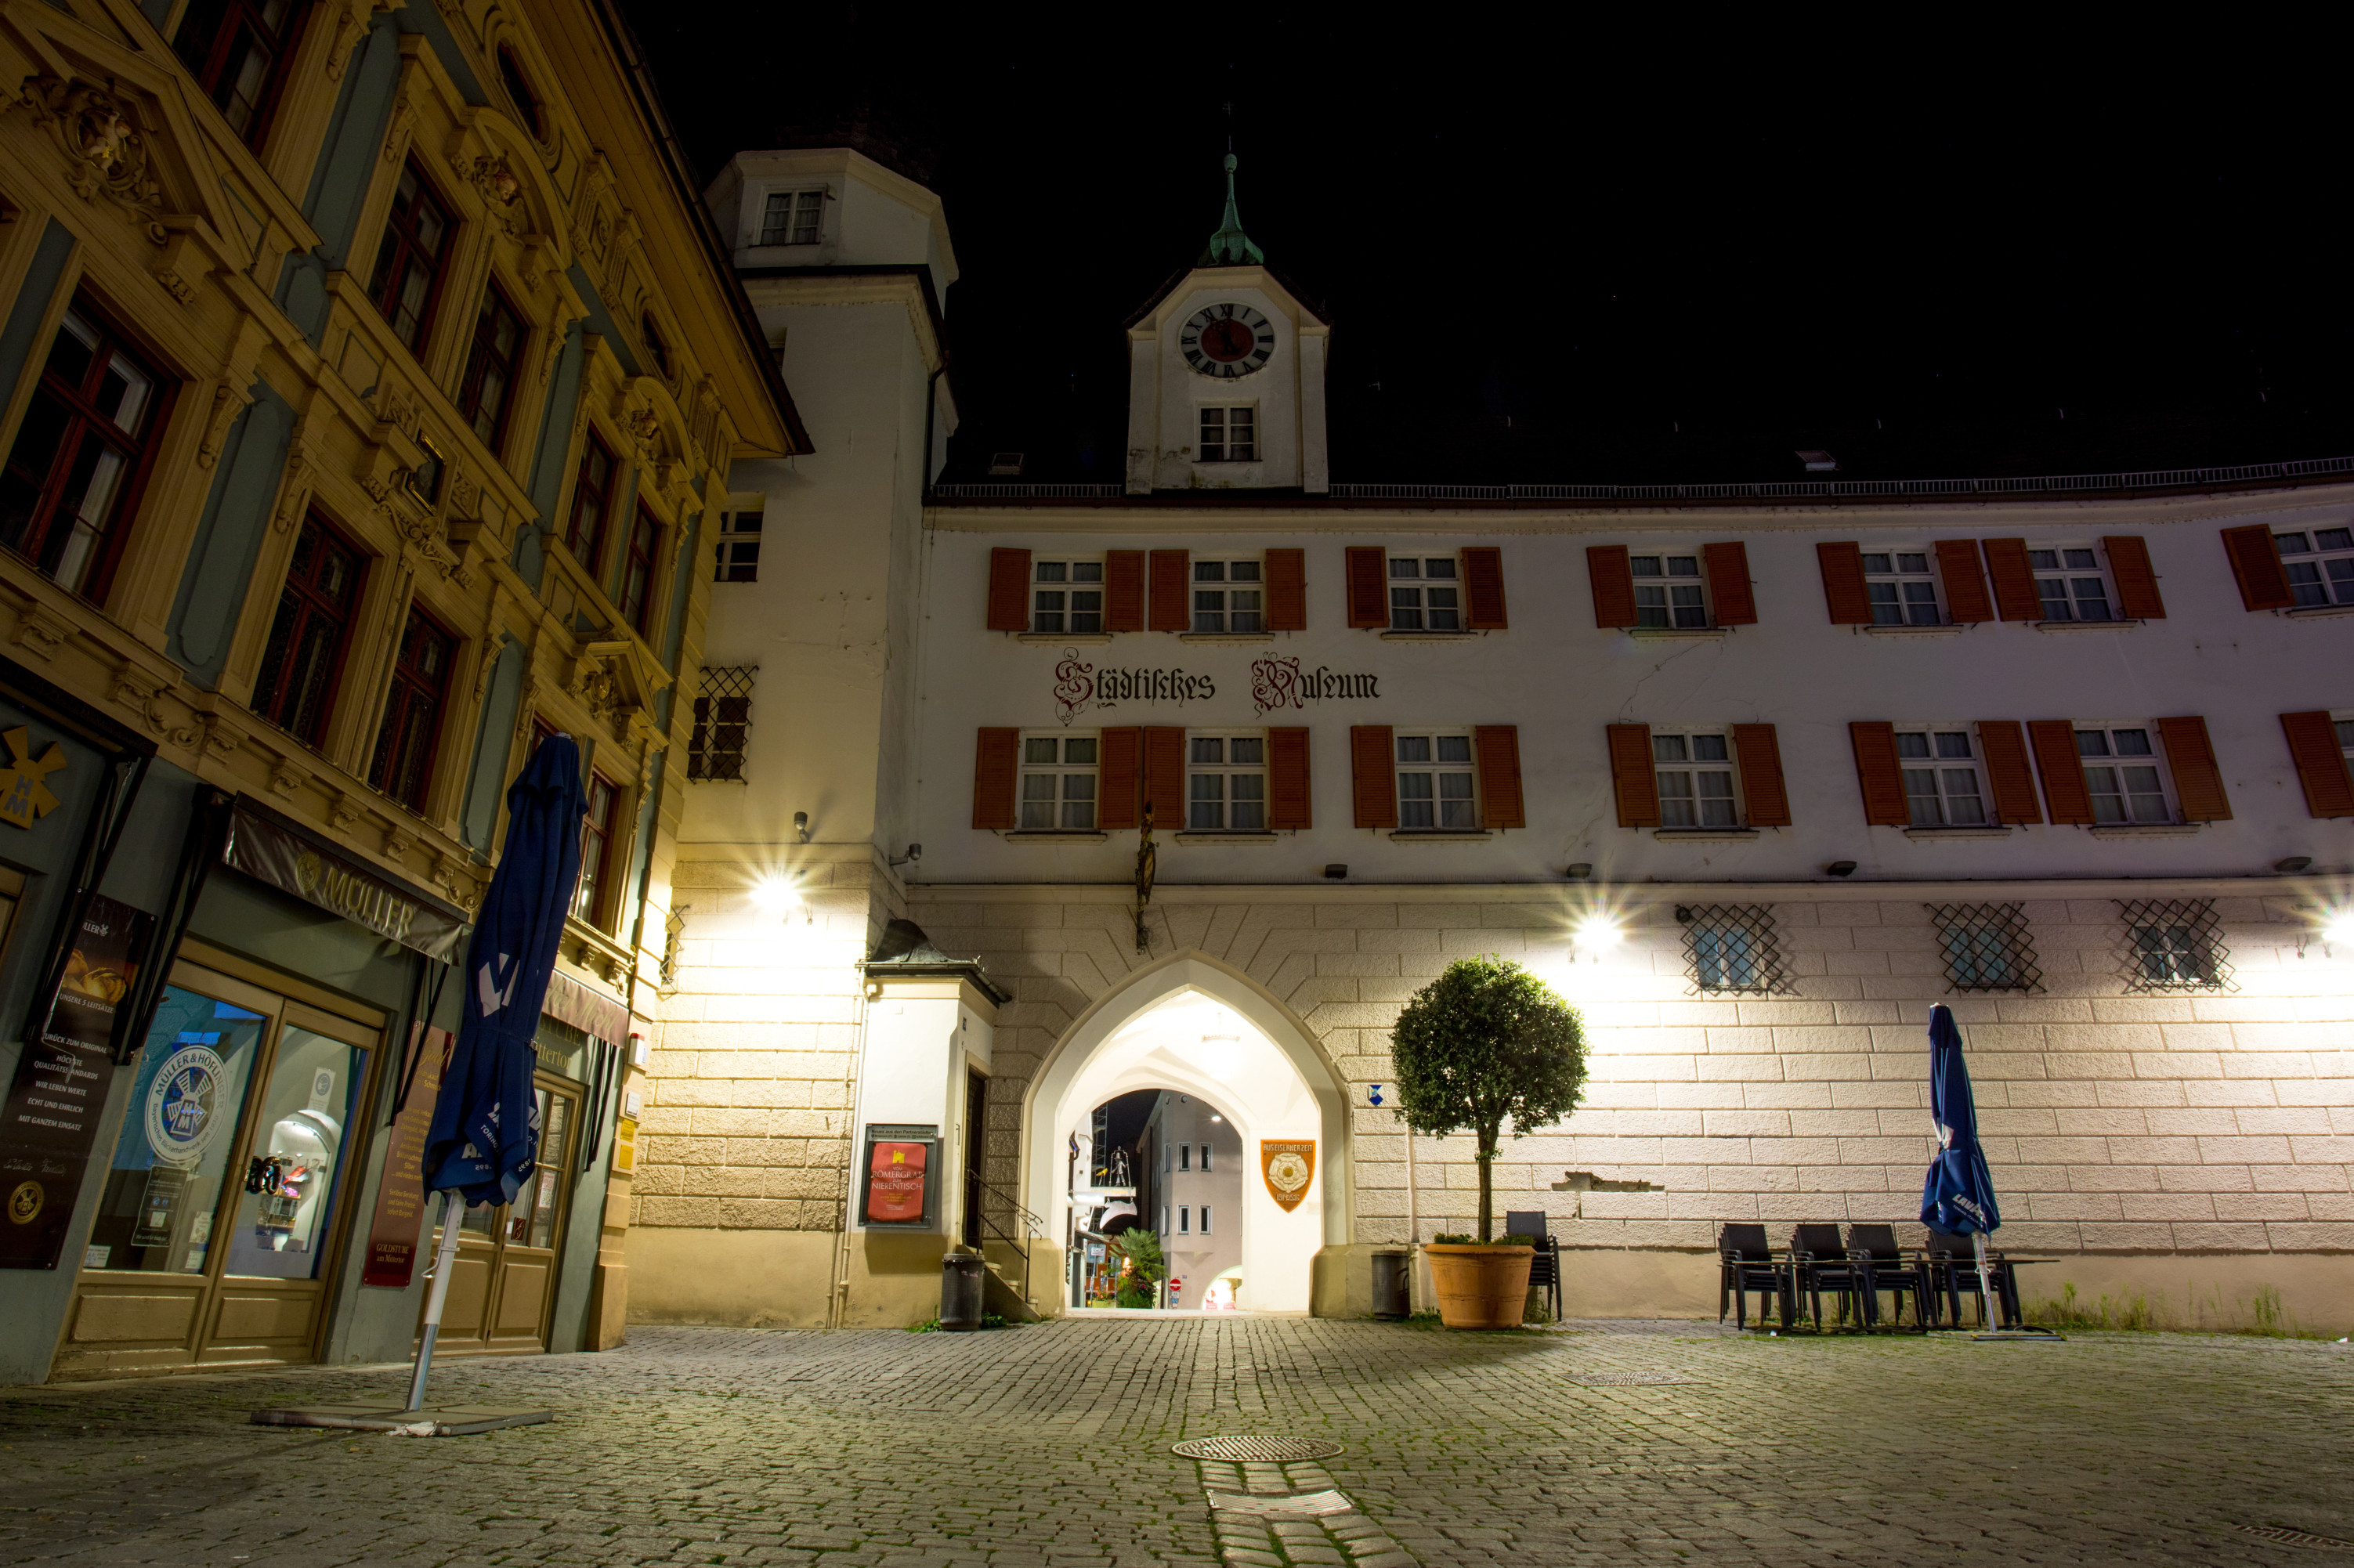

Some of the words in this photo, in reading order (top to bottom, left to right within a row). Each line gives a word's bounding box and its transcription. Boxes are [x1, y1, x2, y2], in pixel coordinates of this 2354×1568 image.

[1220, 304, 1234, 316] XI
[1251, 652, 1381, 720] Museum
[323, 866, 414, 939] MÜLLER
[83, 922, 99, 934] LLER
[60, 993, 81, 1006] UNSERE
[87, 1000, 114, 1013] LEITSÄTZE
[540, 1019, 580, 1046] STUBE
[45, 1032, 65, 1044] URÜCK
[66, 1039, 80, 1047] ZUM
[81, 1042, 107, 1053] ORIGINAL
[537, 1036, 573, 1070] ittertor
[34, 1060, 99, 1080] QUALITÄTSSANDARDS
[35, 1080, 49, 1089] WIR
[49, 1082, 67, 1093] LEBEN
[67, 1086, 86, 1096] WERTE
[27, 1097, 43, 1106] ECHT
[45, 1100, 57, 1109] UND
[58, 1102, 84, 1113] EHRLICH
[32, 1116, 56, 1127] GANZEM
[58, 1120, 81, 1131] EINSATZ
[871, 1182, 922, 1190] NIERENTISCH
[376, 1243, 409, 1254] GOLDSTUBE
[385, 1254, 405, 1263] Mittertor
